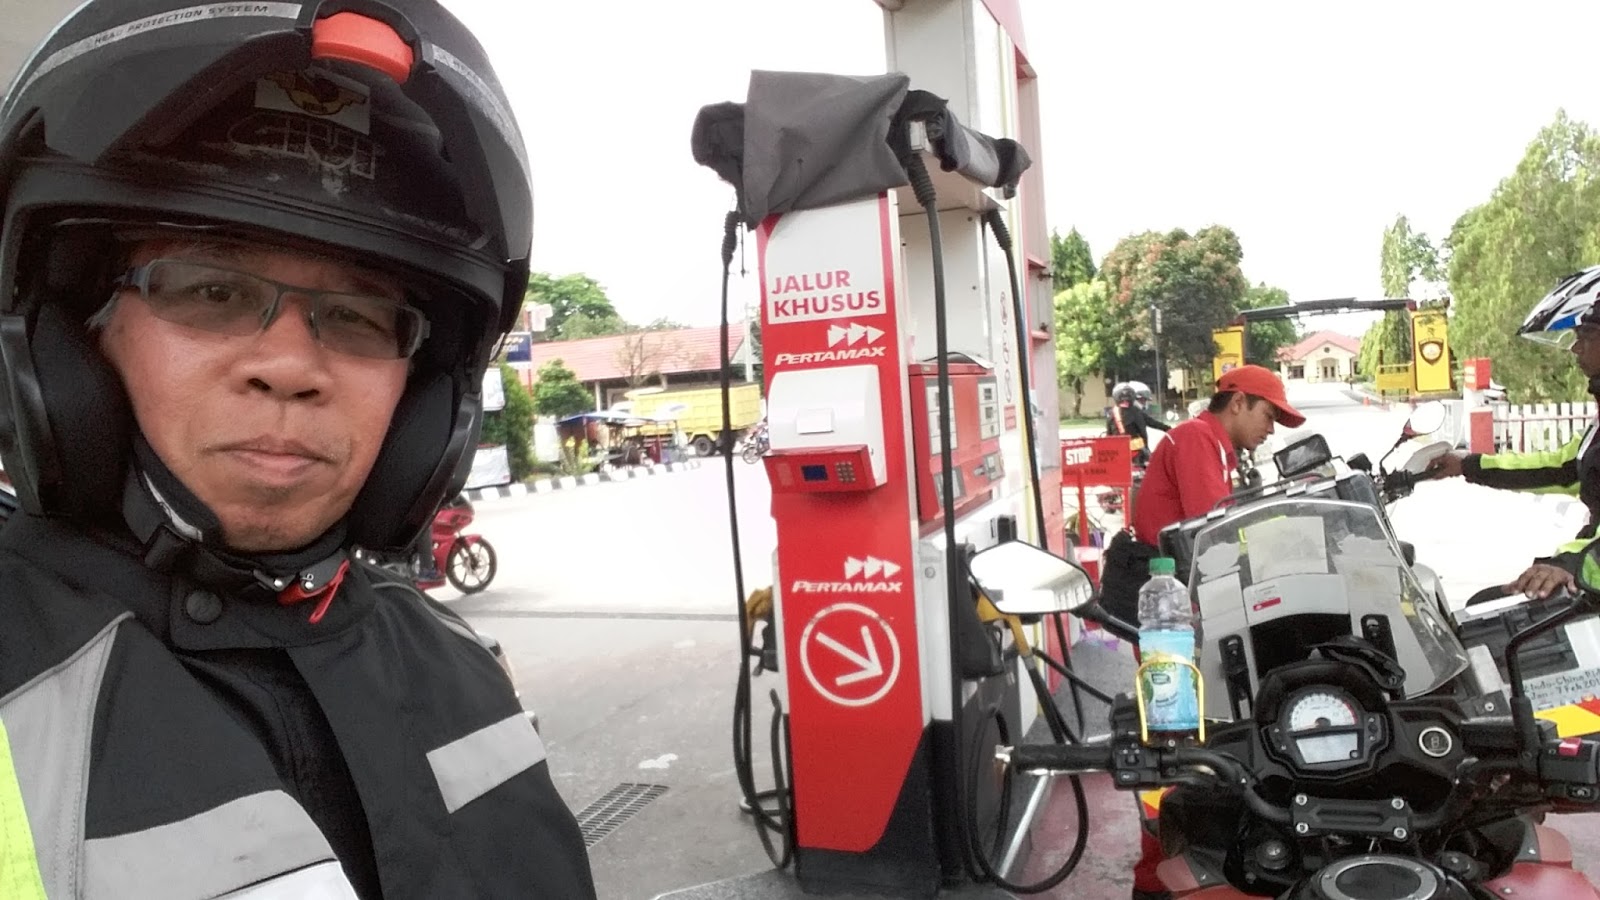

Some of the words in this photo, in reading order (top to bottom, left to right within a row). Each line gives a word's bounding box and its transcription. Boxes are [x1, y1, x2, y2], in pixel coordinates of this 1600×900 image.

[127, 9, 203, 32] PROTECTION
[208, 5, 268, 15] SYSTEM
[772, 270, 851, 294] JALUR
[774, 291, 881, 317] KHUSUS
[775, 346, 886, 366] PERTAMAX
[1065, 447, 1093, 465] STOP
[792, 580, 903, 593] PERTAMAX
